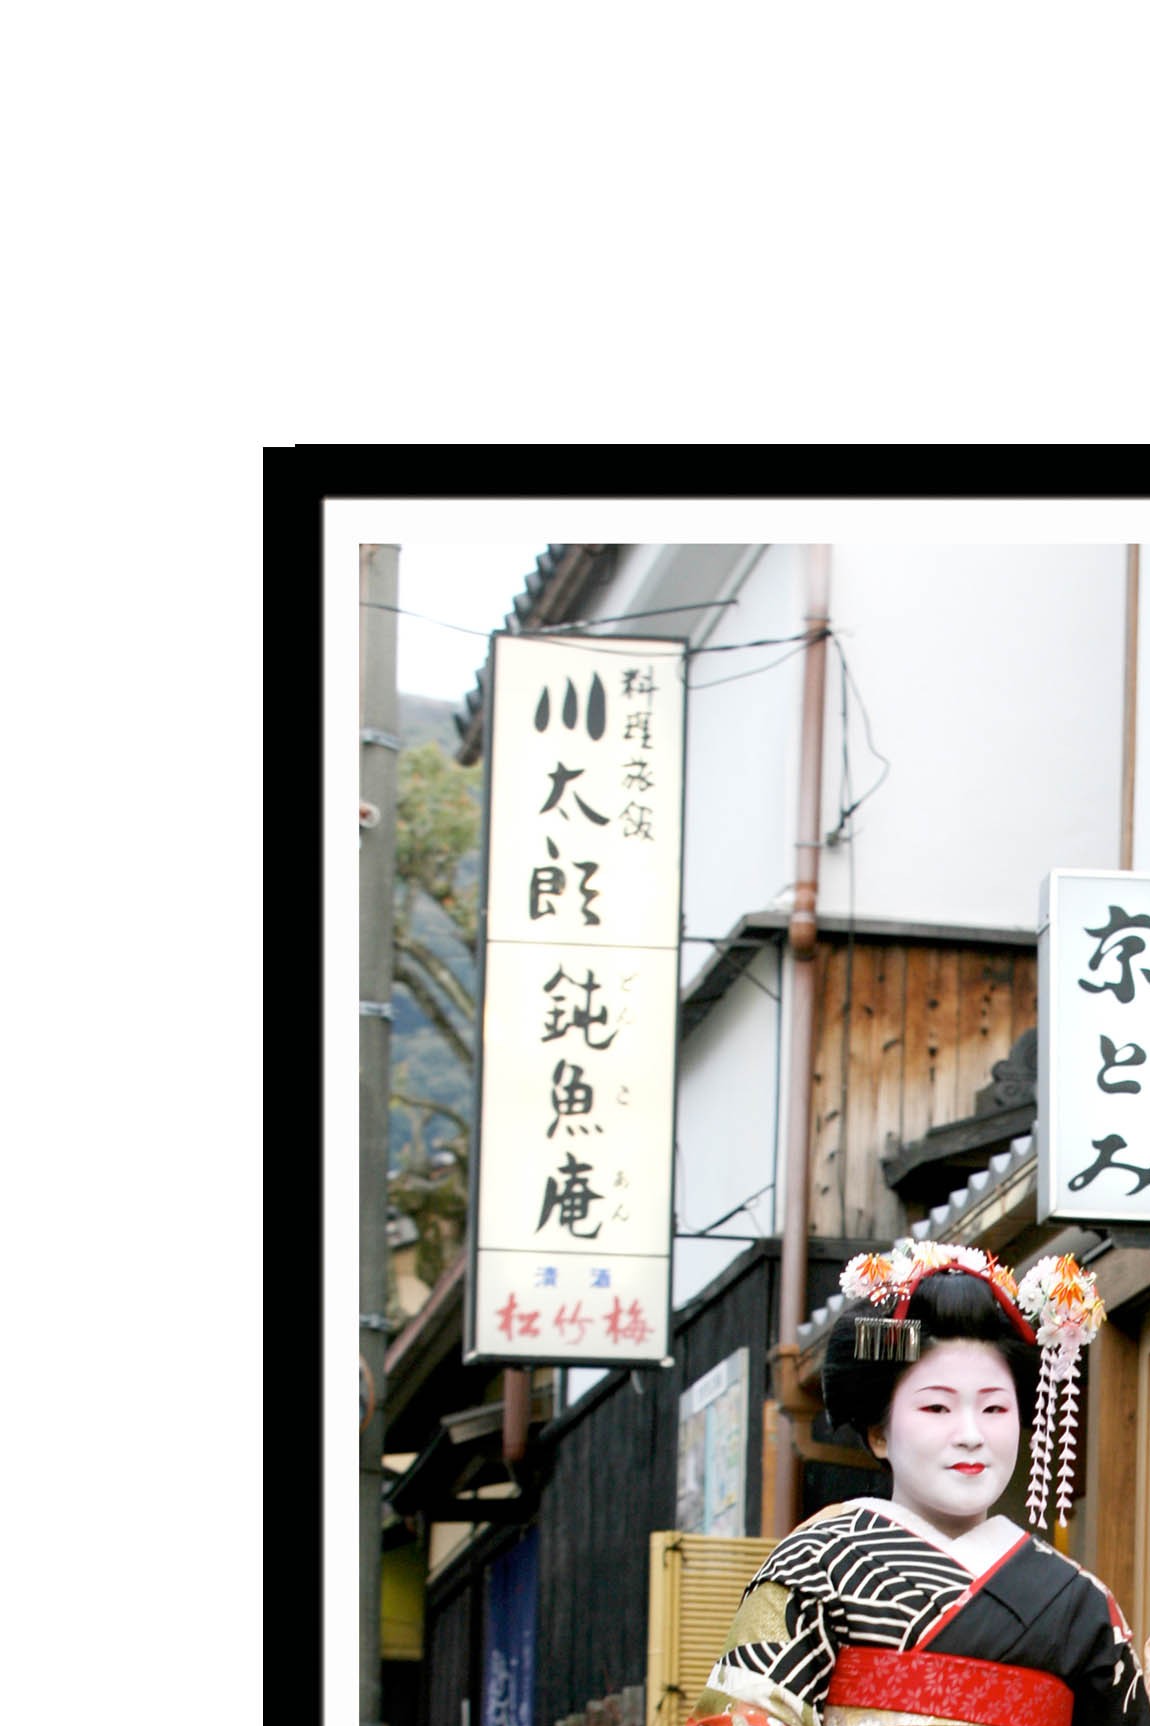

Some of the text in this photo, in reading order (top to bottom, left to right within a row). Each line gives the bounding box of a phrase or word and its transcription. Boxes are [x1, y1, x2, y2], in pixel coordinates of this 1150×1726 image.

[529, 670, 611, 926] 川太郎
[535, 963, 619, 1240] 鈍魚庵
[495, 1292, 655, 1345] 松竹梅
[534, 1266, 611, 1288] 清酒
